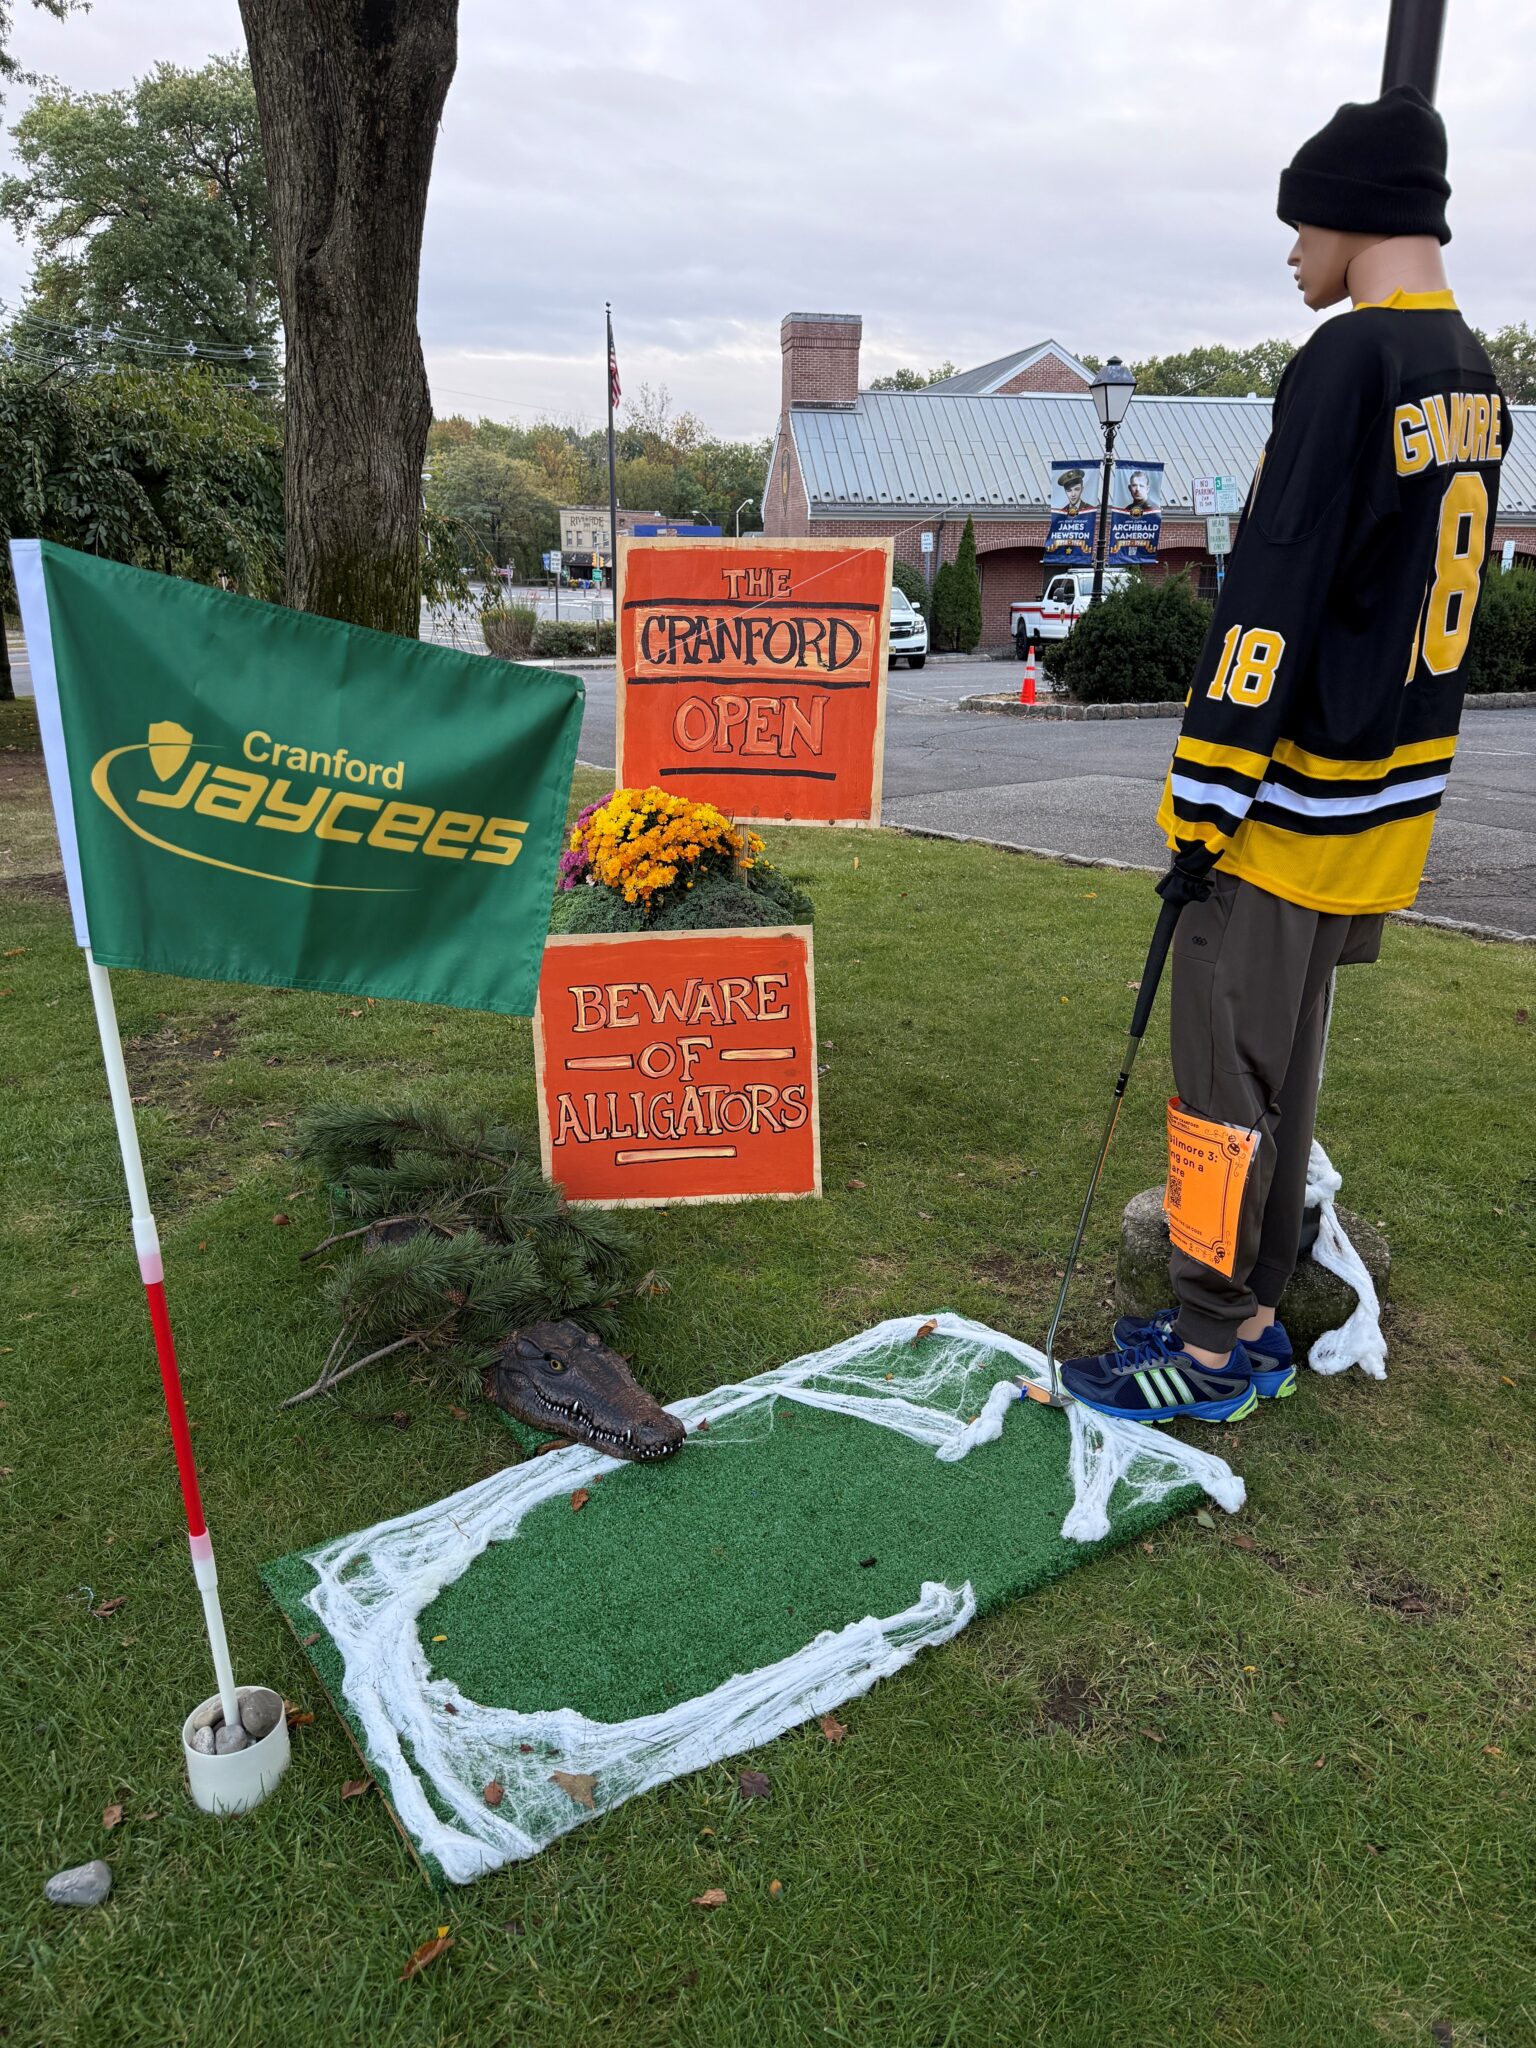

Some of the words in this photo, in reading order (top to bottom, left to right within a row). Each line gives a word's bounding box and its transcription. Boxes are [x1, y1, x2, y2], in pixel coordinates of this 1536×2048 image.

[1200, 480, 1209, 488] NO
[1216, 480, 1221, 488] 3
[1195, 488, 1215, 496] PARKING
[1058, 523, 1085, 531] JAMES
[1112, 523, 1160, 532] ARCHIBALD
[1051, 532, 1090, 540] HEWSTON
[1114, 532, 1155, 540] CAMERON
[721, 567, 793, 600] THE
[641, 615, 862, 672] CRANFORD
[1206, 624, 1286, 708] 18
[672, 695, 831, 759] OPEN
[242, 730, 405, 791] Cranford
[568, 972, 790, 1033] BEWARE
[637, 1035, 714, 1083] OF
[553, 1083, 809, 1146] ALLIGATORS
[1207, 1151, 1218, 1163] 3:
[1183, 1158, 1195, 1169] on
[1197, 1164, 1204, 1173] a
